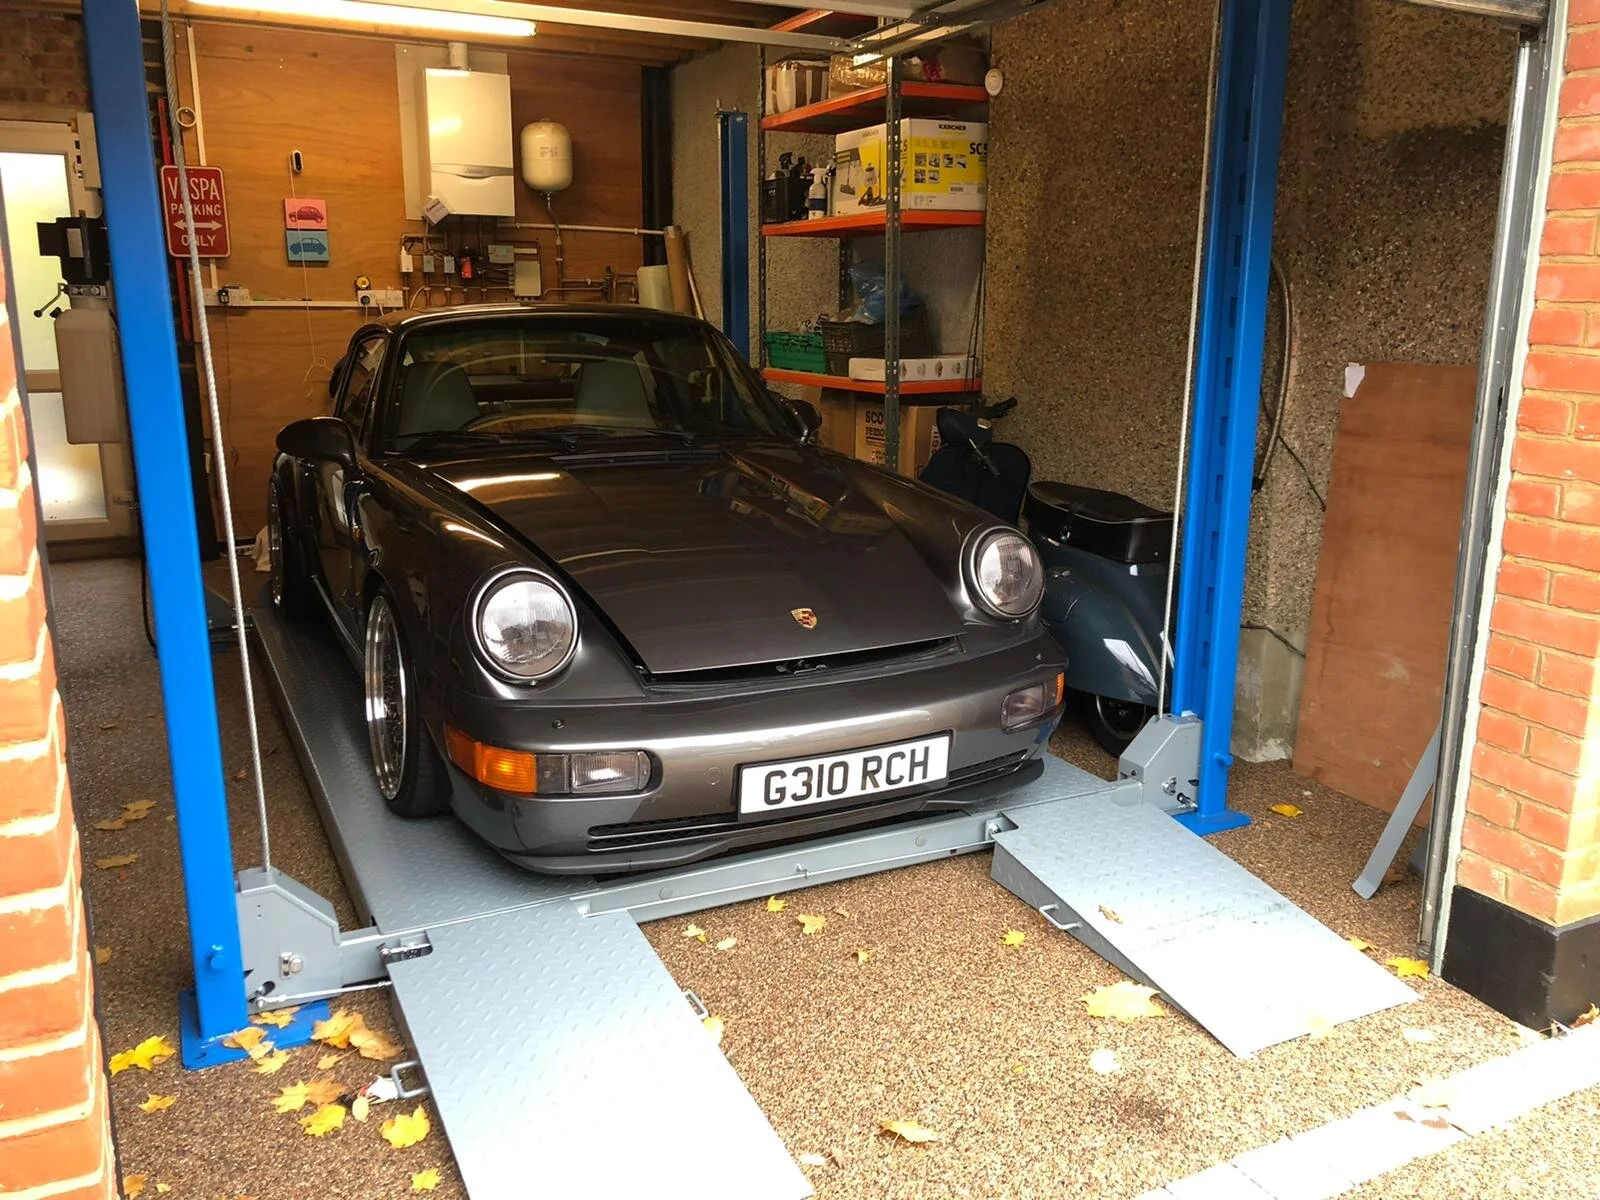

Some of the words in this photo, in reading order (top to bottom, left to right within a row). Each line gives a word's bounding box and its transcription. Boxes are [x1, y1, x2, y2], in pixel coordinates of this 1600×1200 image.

[167, 177, 221, 200] VSPA
[170, 203, 222, 216] PAKING
[865, 410, 884, 425] SCO
[865, 426, 886, 438] remo
[763, 760, 850, 806] G310
[860, 745, 931, 792] RCH
